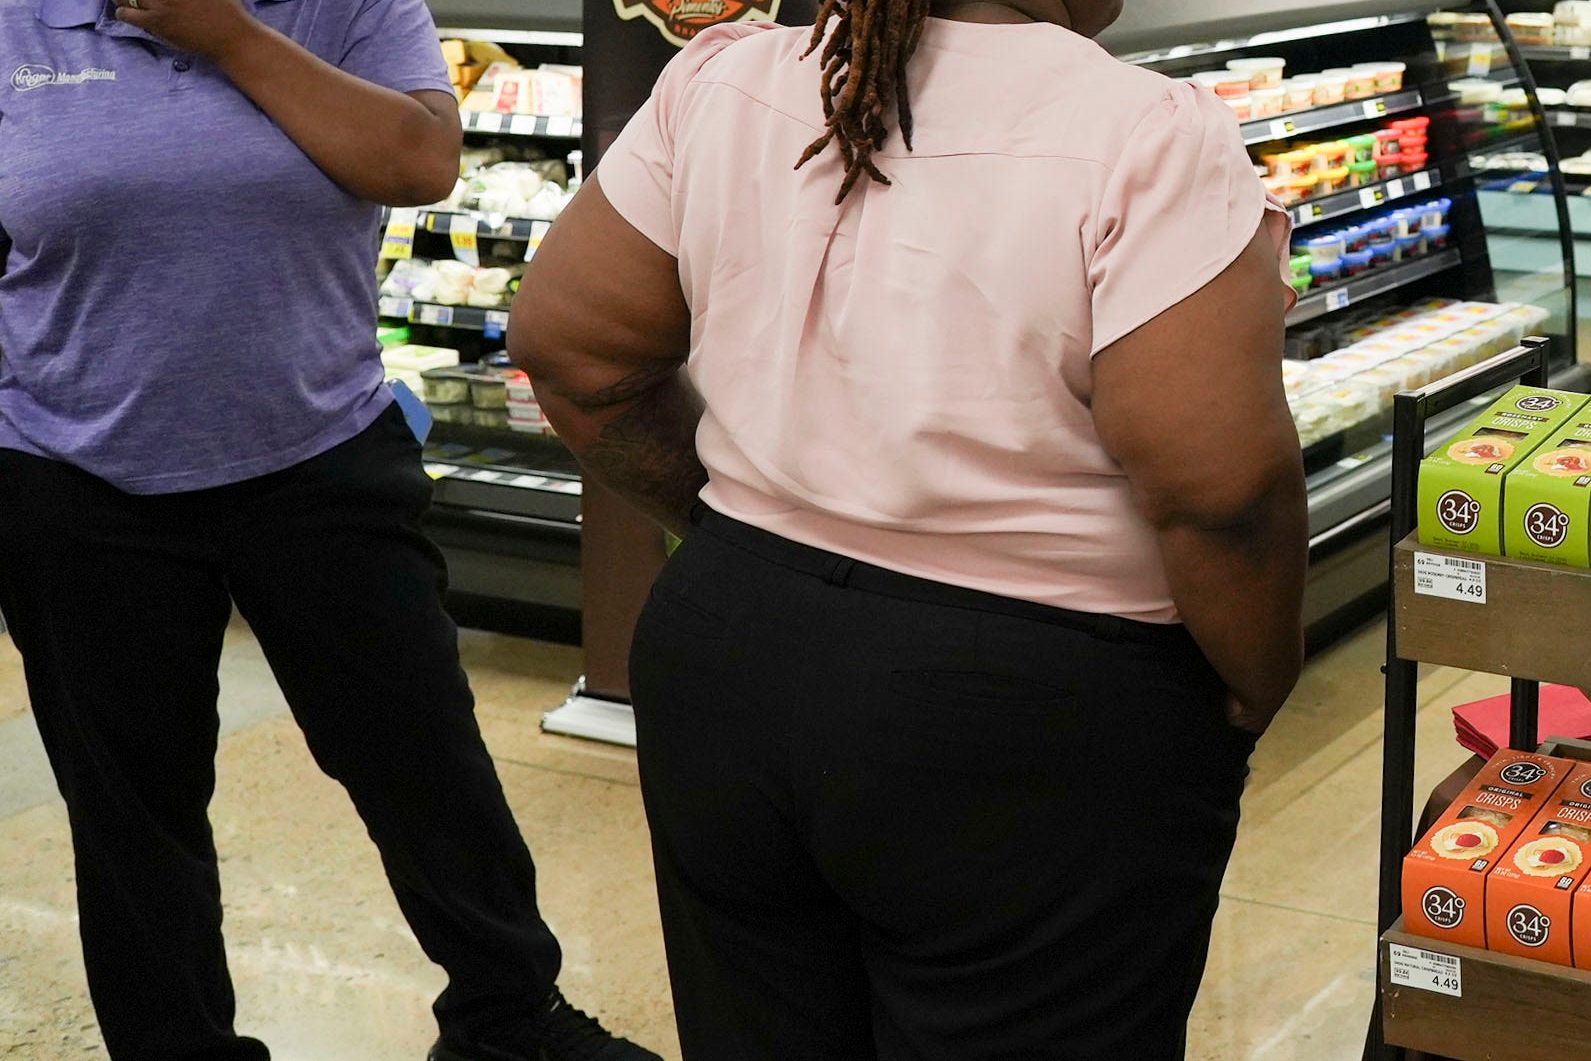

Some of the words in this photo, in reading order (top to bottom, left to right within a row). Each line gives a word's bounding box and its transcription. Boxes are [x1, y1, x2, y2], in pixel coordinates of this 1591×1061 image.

[15, 67, 52, 87] Kroger
[1491, 416, 1538, 430] CRISPS
[1443, 498, 1481, 524] 34°
[1449, 521, 1466, 529] CRISPS
[1530, 511, 1569, 537] 34°
[1536, 534, 1554, 542] CRISPS
[1456, 583, 1483, 597] 4.49
[1505, 765, 1547, 780] 34°
[1487, 786, 1524, 797] ORIGINAL
[1475, 792, 1522, 810] CRISPS
[1428, 894, 1465, 918] 34°
[1513, 912, 1550, 937] 34°
[1432, 976, 1459, 990] 4.49
